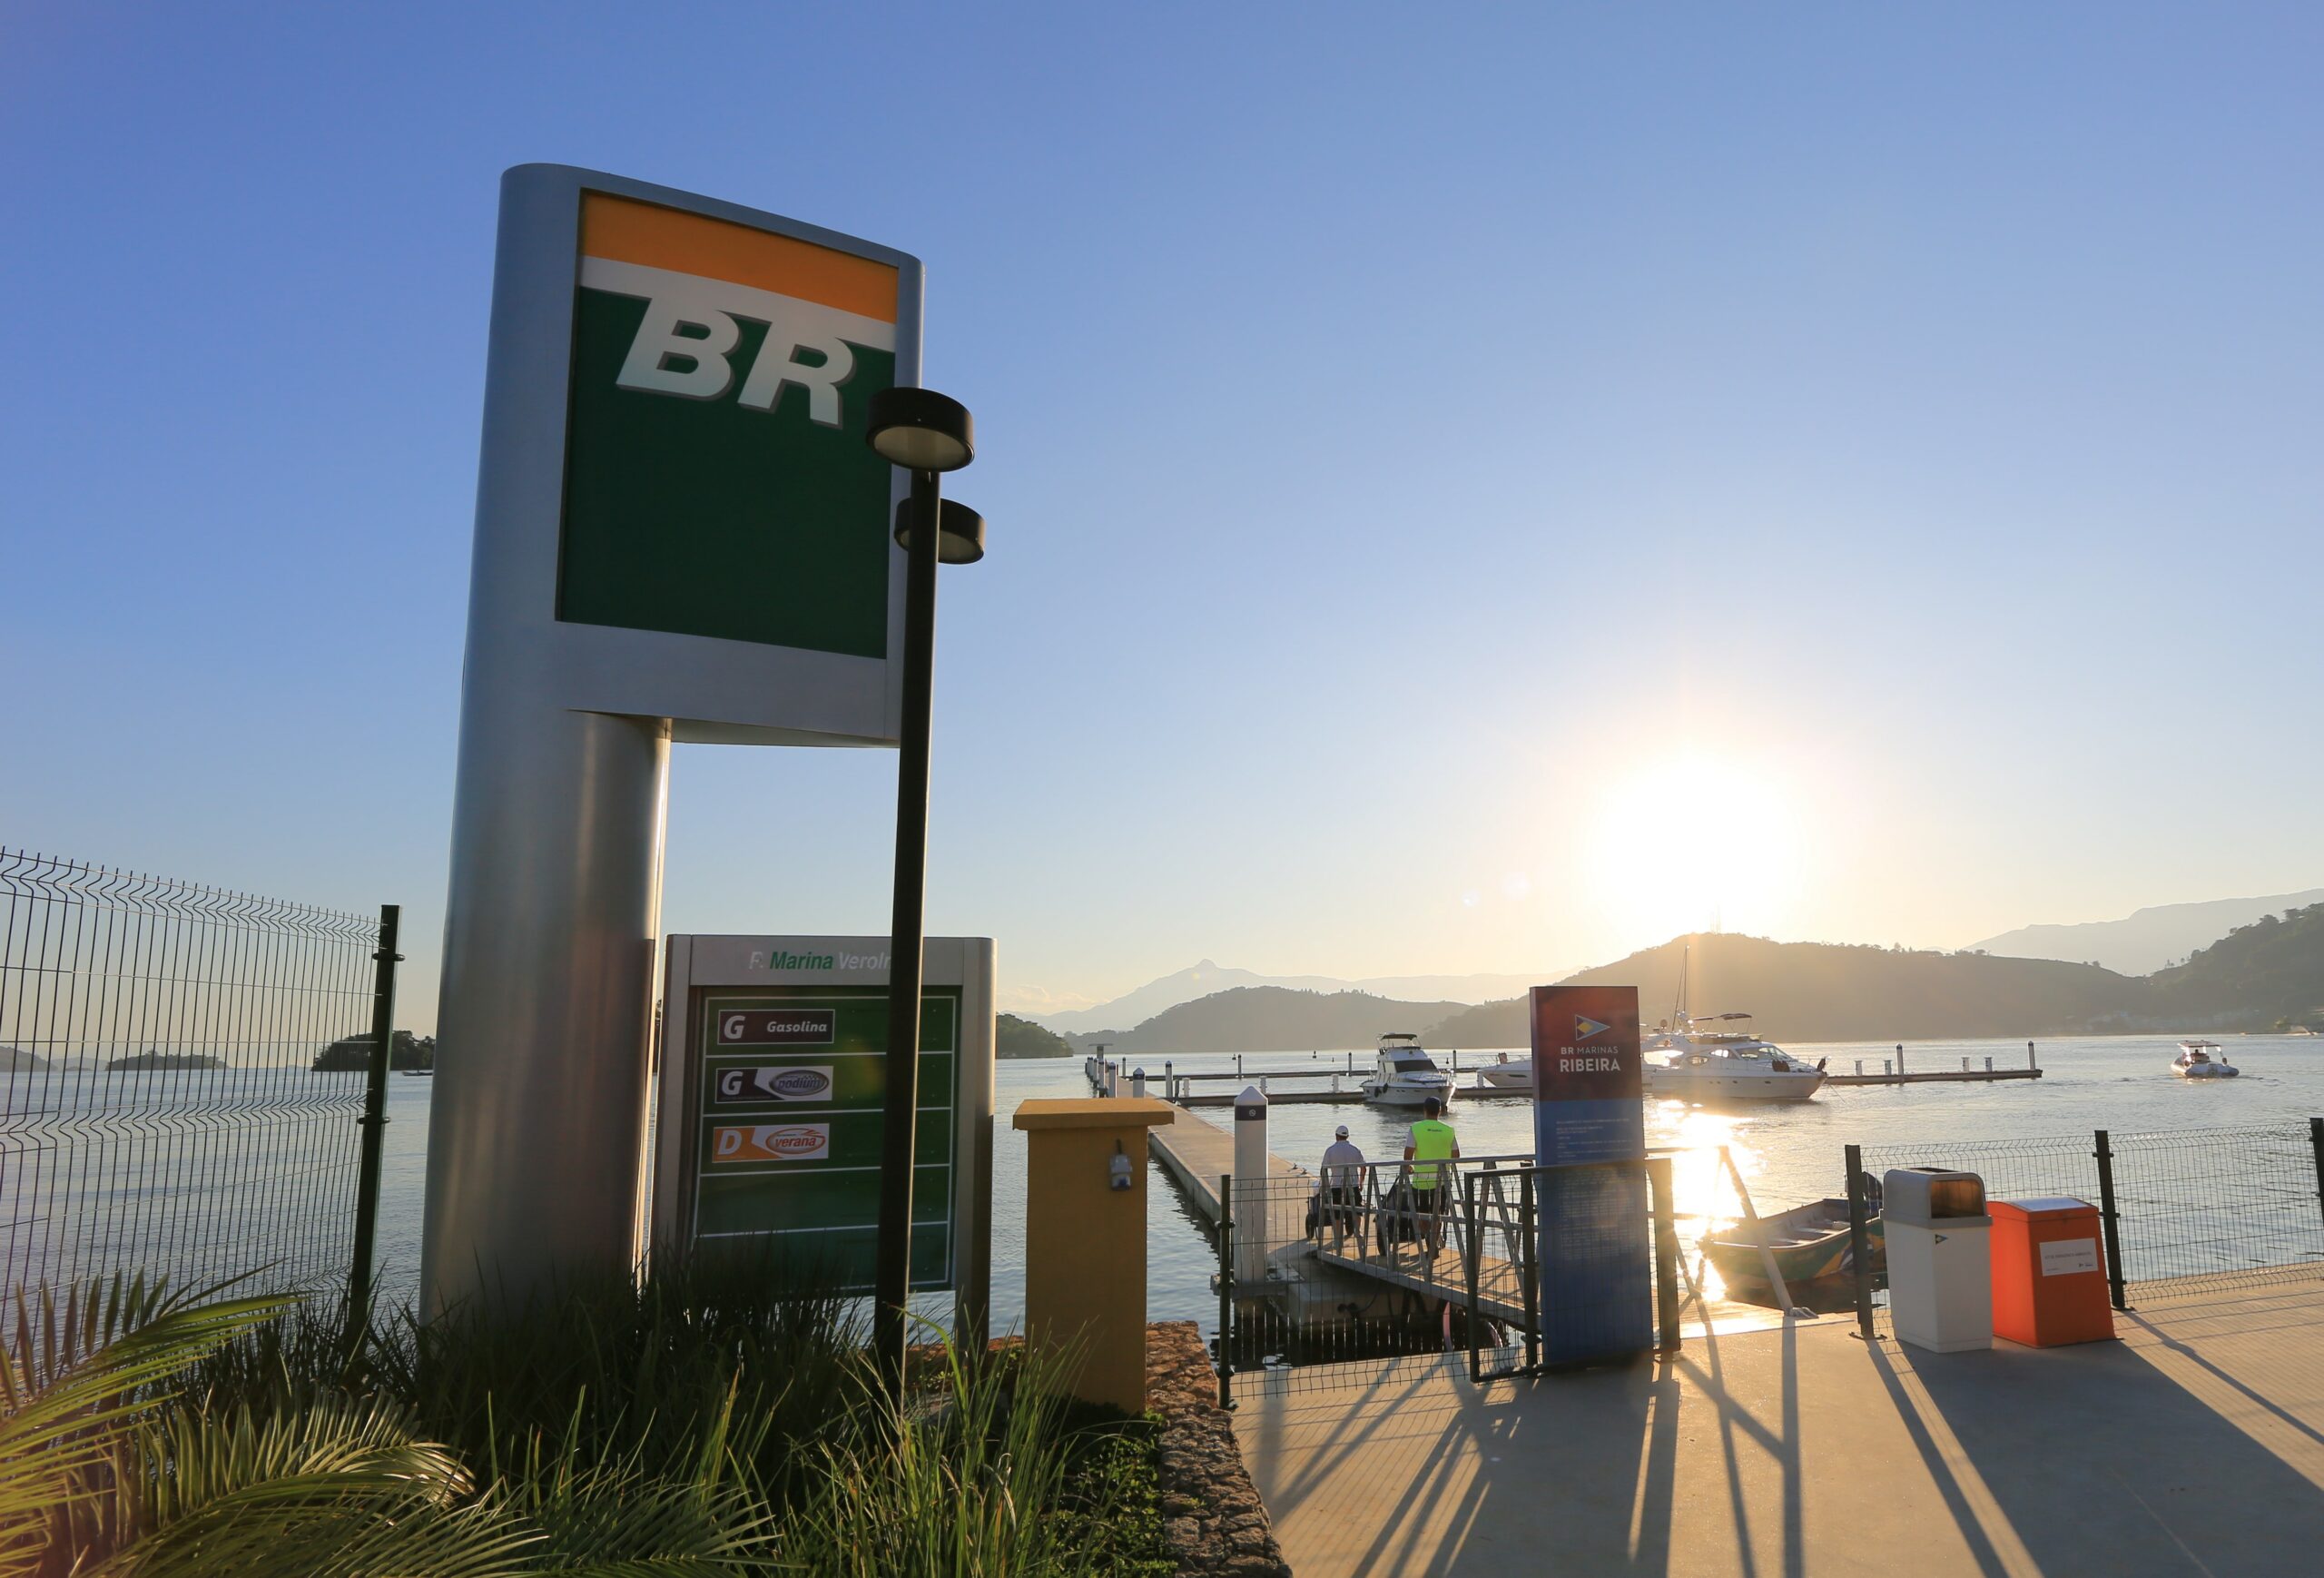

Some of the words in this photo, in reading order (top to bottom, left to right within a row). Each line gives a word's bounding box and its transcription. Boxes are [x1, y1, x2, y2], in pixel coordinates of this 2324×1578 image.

[615, 297, 857, 429] BR
[769, 951, 833, 970] Marina
[724, 1015, 746, 1040] G
[766, 1021, 828, 1033] Gasolina
[1561, 1046, 1574, 1055] BR
[1577, 1046, 1619, 1054] MARINAS
[1560, 1058, 1621, 1072] RIBEIRA
[721, 1070, 743, 1096] G
[777, 1077, 821, 1090] podium
[717, 1129, 743, 1155] D
[774, 1136, 817, 1148] verana
